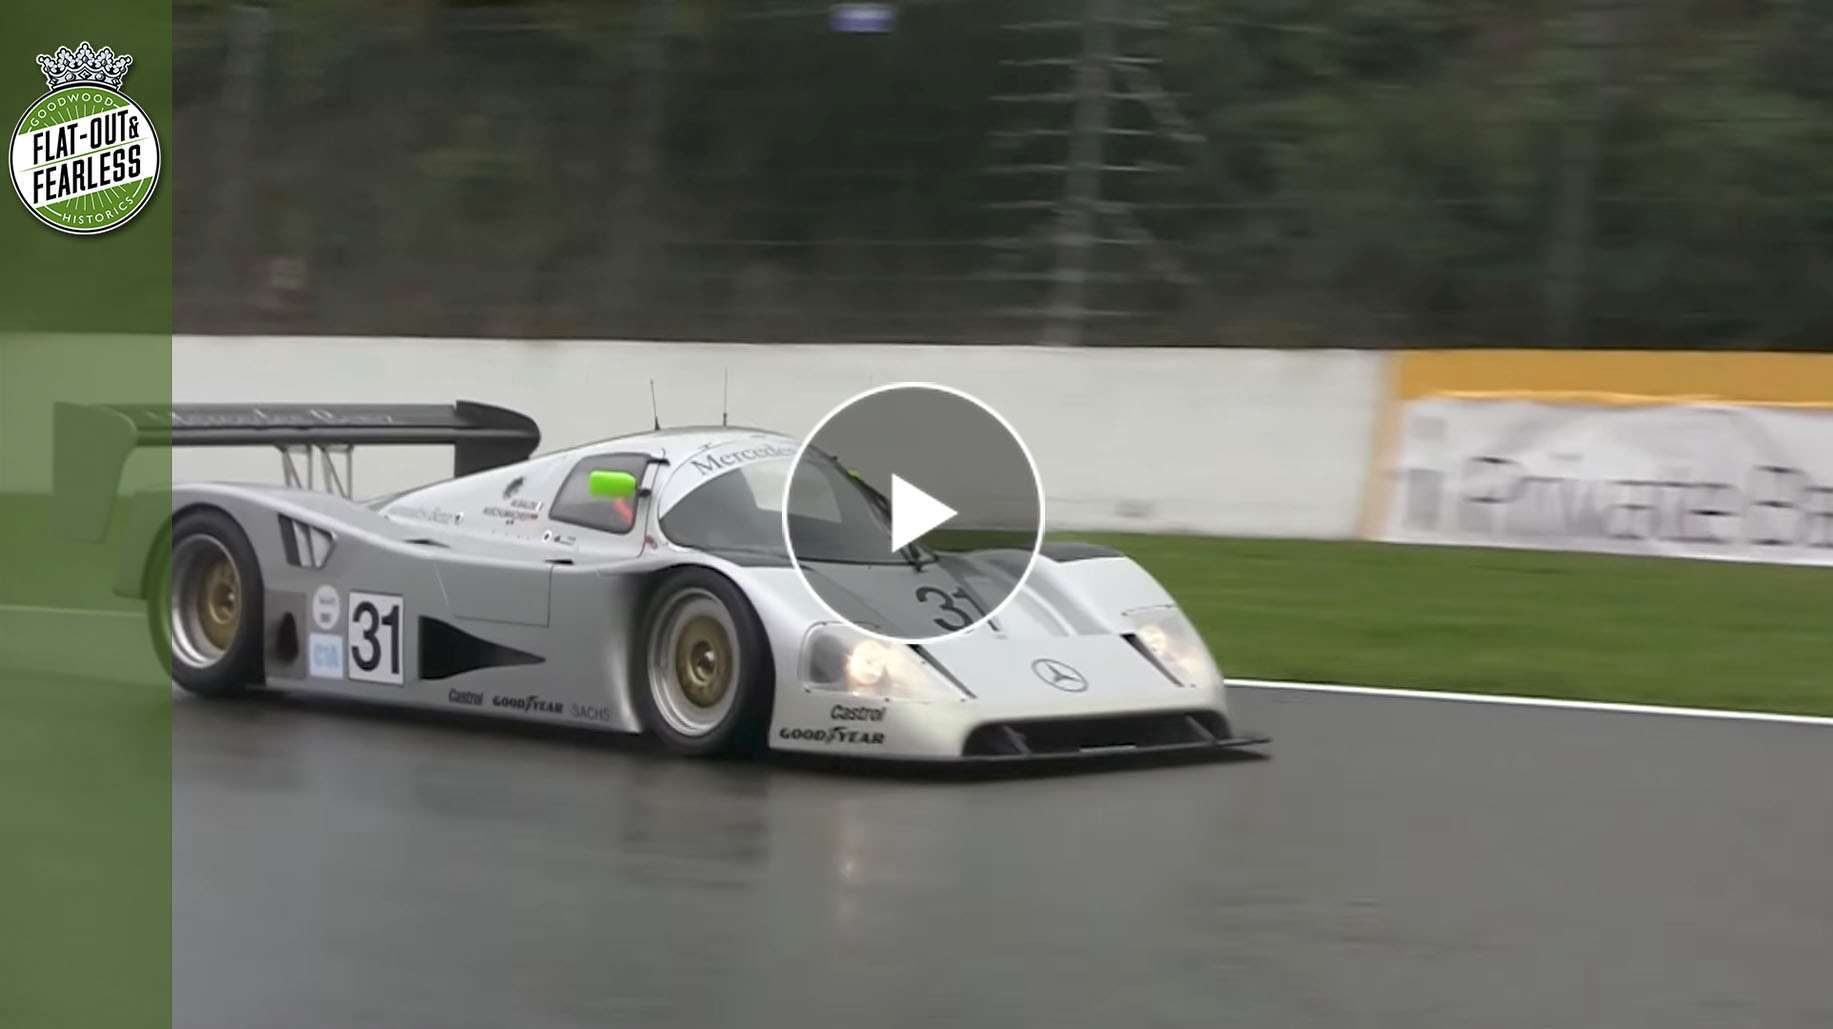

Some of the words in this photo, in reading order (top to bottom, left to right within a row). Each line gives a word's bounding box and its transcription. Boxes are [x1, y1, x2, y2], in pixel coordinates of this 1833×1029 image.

[916, 586, 1001, 632] 31
[352, 601, 400, 674] 31
[449, 688, 483, 706] Castrol
[492, 696, 564, 714] GOODYEAR
[570, 704, 611, 721] SACHS
[830, 704, 886, 721] Castrol
[779, 725, 885, 744] GOODYEAR
